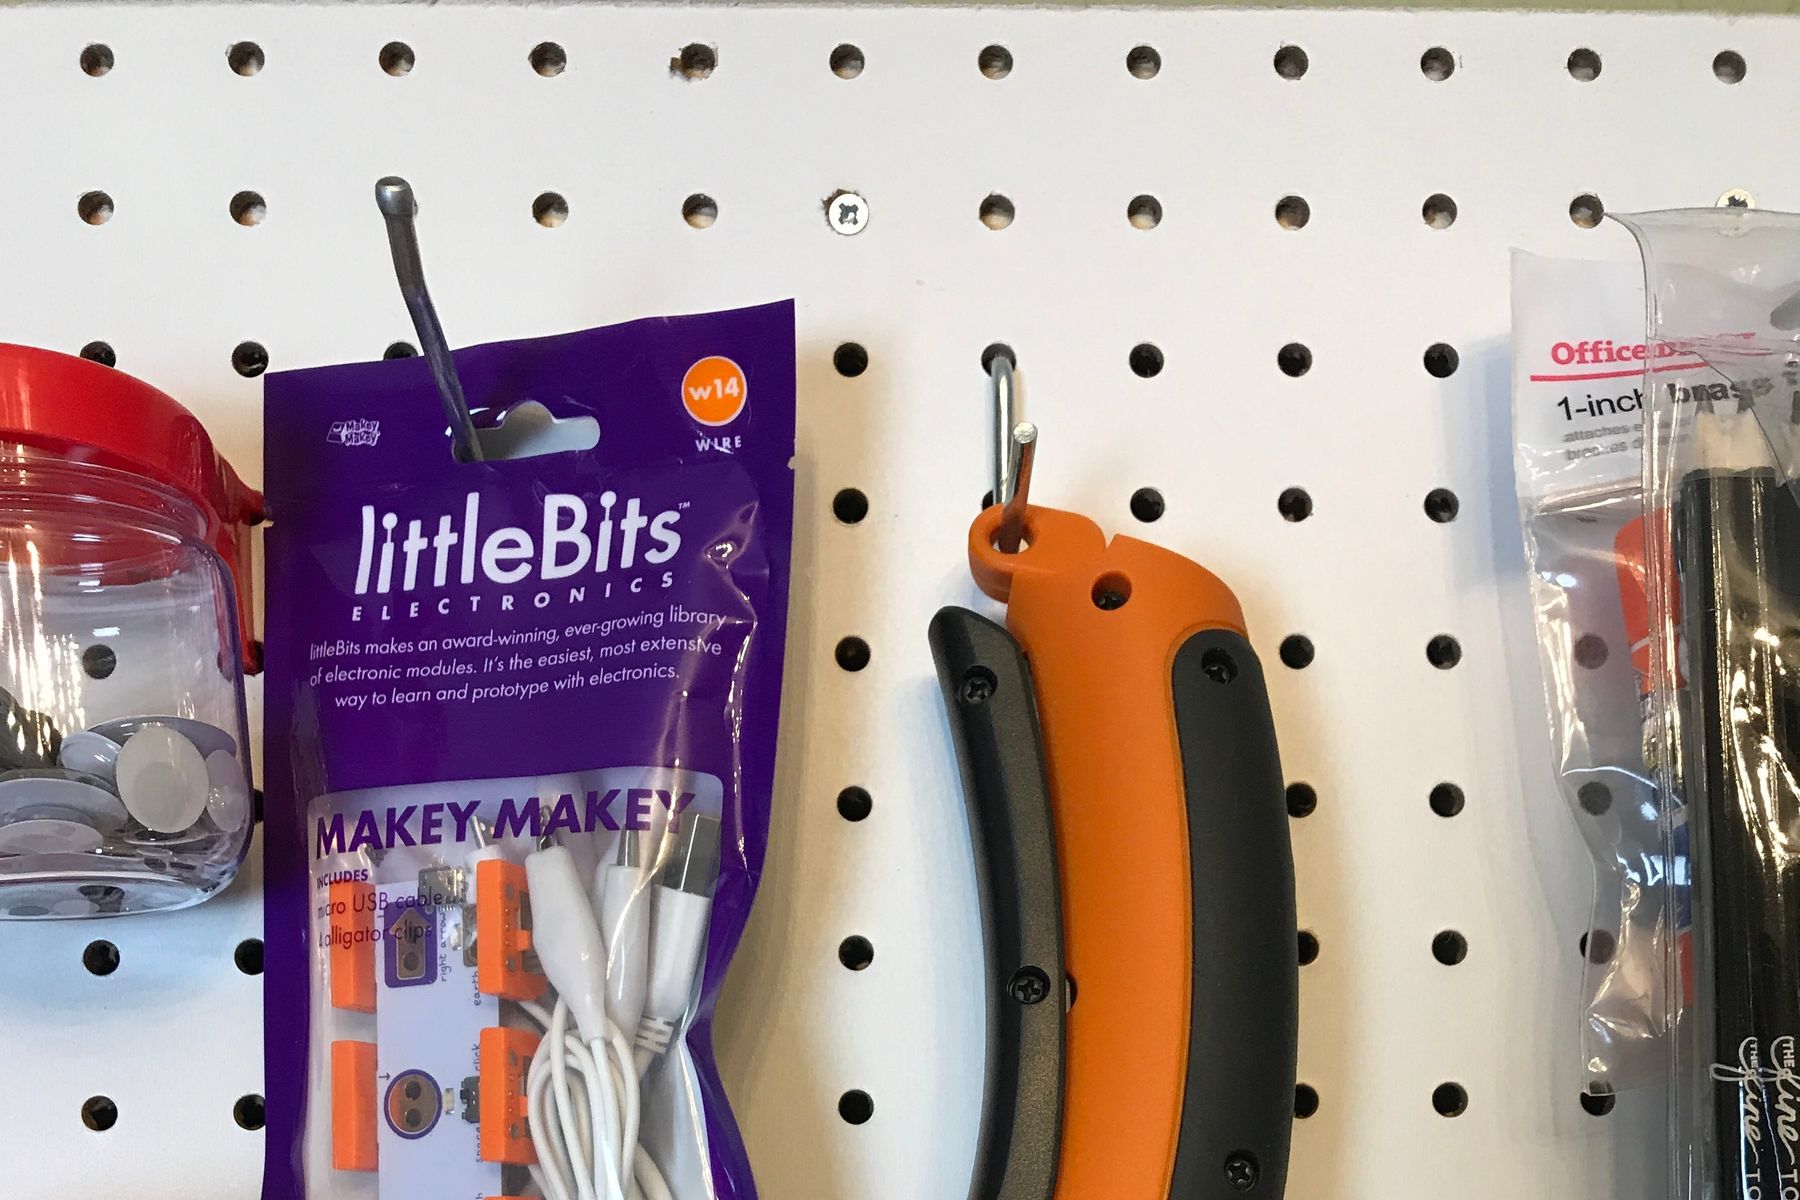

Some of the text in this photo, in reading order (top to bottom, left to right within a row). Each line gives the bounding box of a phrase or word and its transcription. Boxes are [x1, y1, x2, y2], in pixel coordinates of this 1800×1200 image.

[689, 376, 740, 401] w14
[695, 435, 742, 452] WIRE
[354, 491, 682, 594] littleBits
[352, 571, 673, 621] ELECTRONICS
[310, 604, 727, 661] littleBits makes an award-winning, ever-growing library
[310, 667, 324, 686] of
[325, 665, 401, 682] electronic
[406, 659, 478, 678] modules.
[509, 652, 533, 670] the
[538, 646, 594, 667] easiest,
[600, 639, 637, 658] most
[640, 636, 722, 656] extensive
[335, 663, 680, 710] way to learn and prototype with electronics.
[317, 788, 696, 860] MAKEY MAKEY
[316, 869, 369, 889] INCLUDES
[353, 892, 389, 912] USB
[395, 886, 443, 908] cable
[325, 925, 387, 950] alligator
[394, 919, 433, 944] clips
[438, 911, 452, 982] right arrow
[1750, 1043, 1759, 1069] THE
[1782, 1041, 1795, 1069] THE
